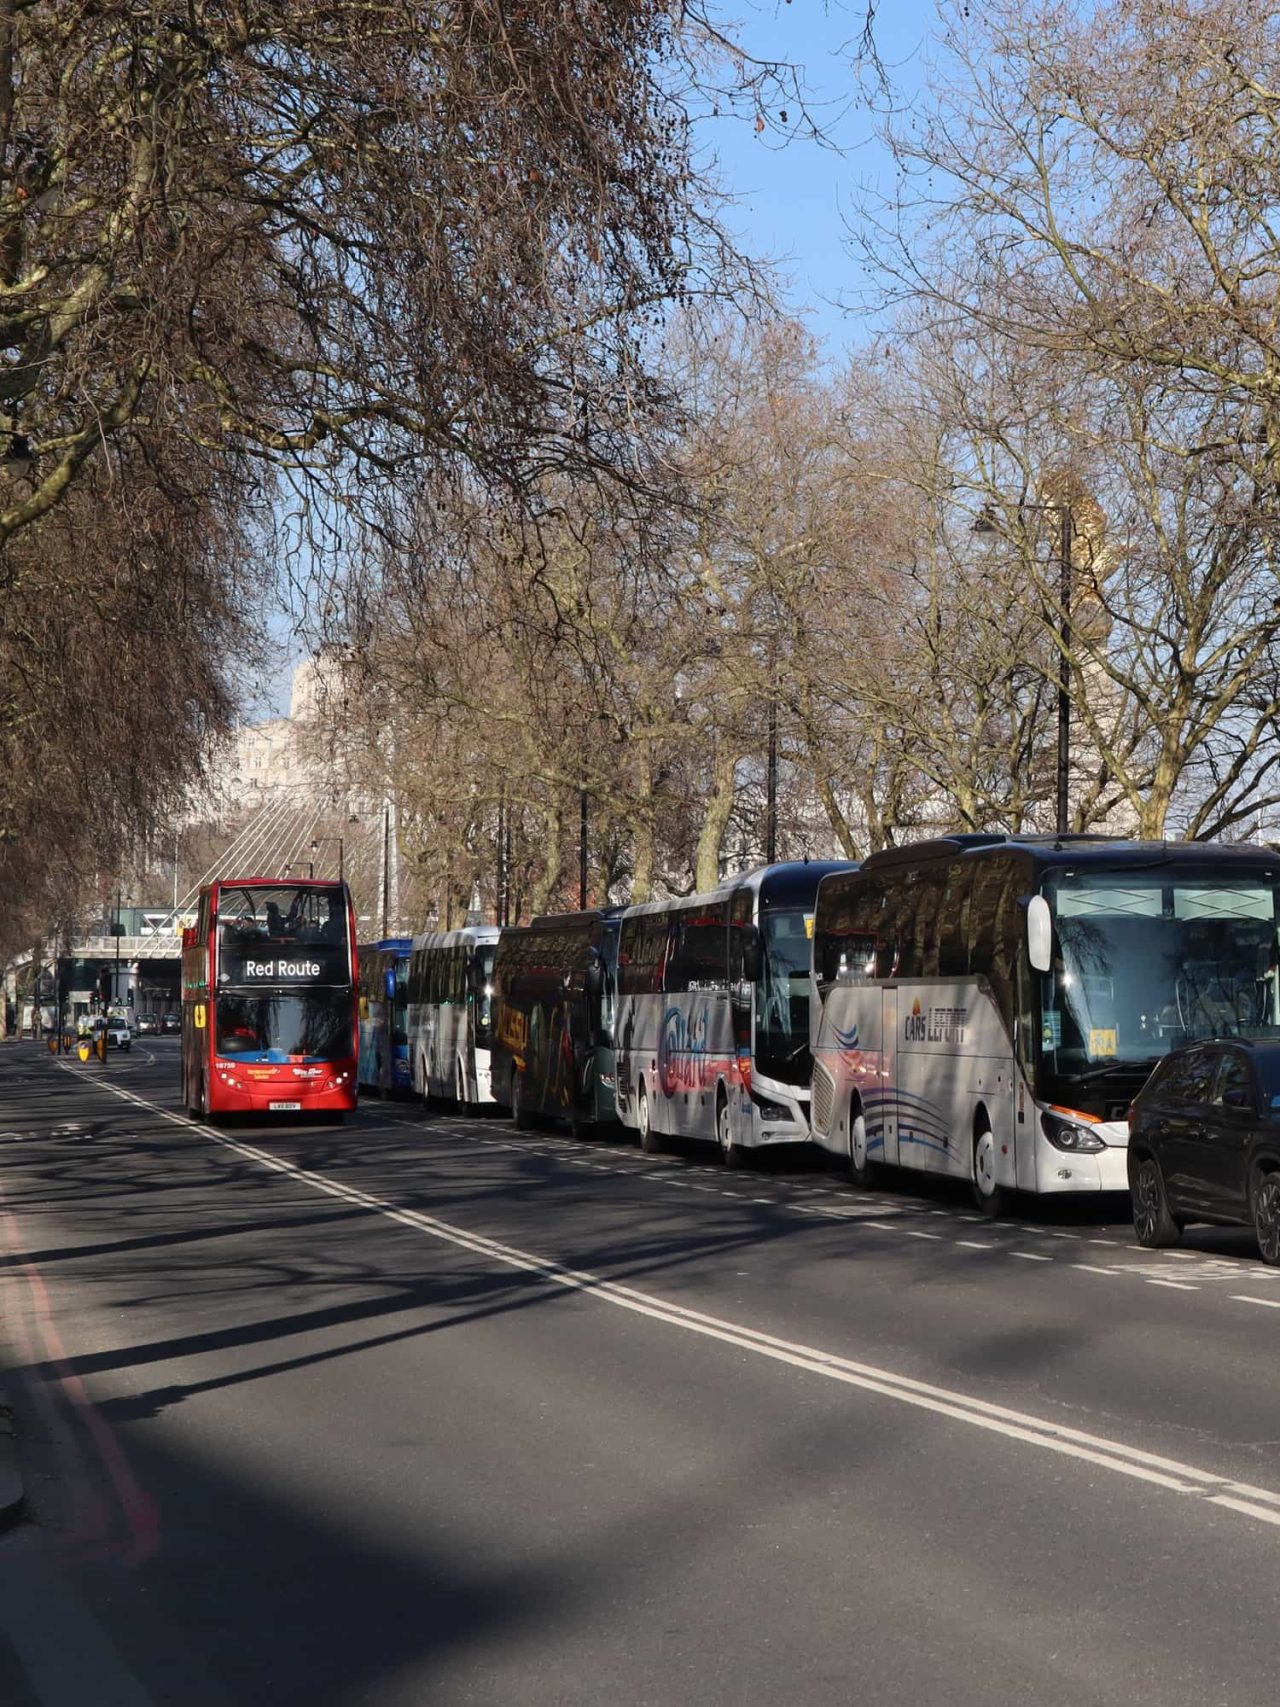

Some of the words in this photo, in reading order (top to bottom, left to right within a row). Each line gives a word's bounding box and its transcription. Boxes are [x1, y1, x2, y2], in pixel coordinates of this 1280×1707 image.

[246, 960, 273, 976] Red
[278, 960, 320, 976] Route
[905, 1015, 926, 1041] CARS
